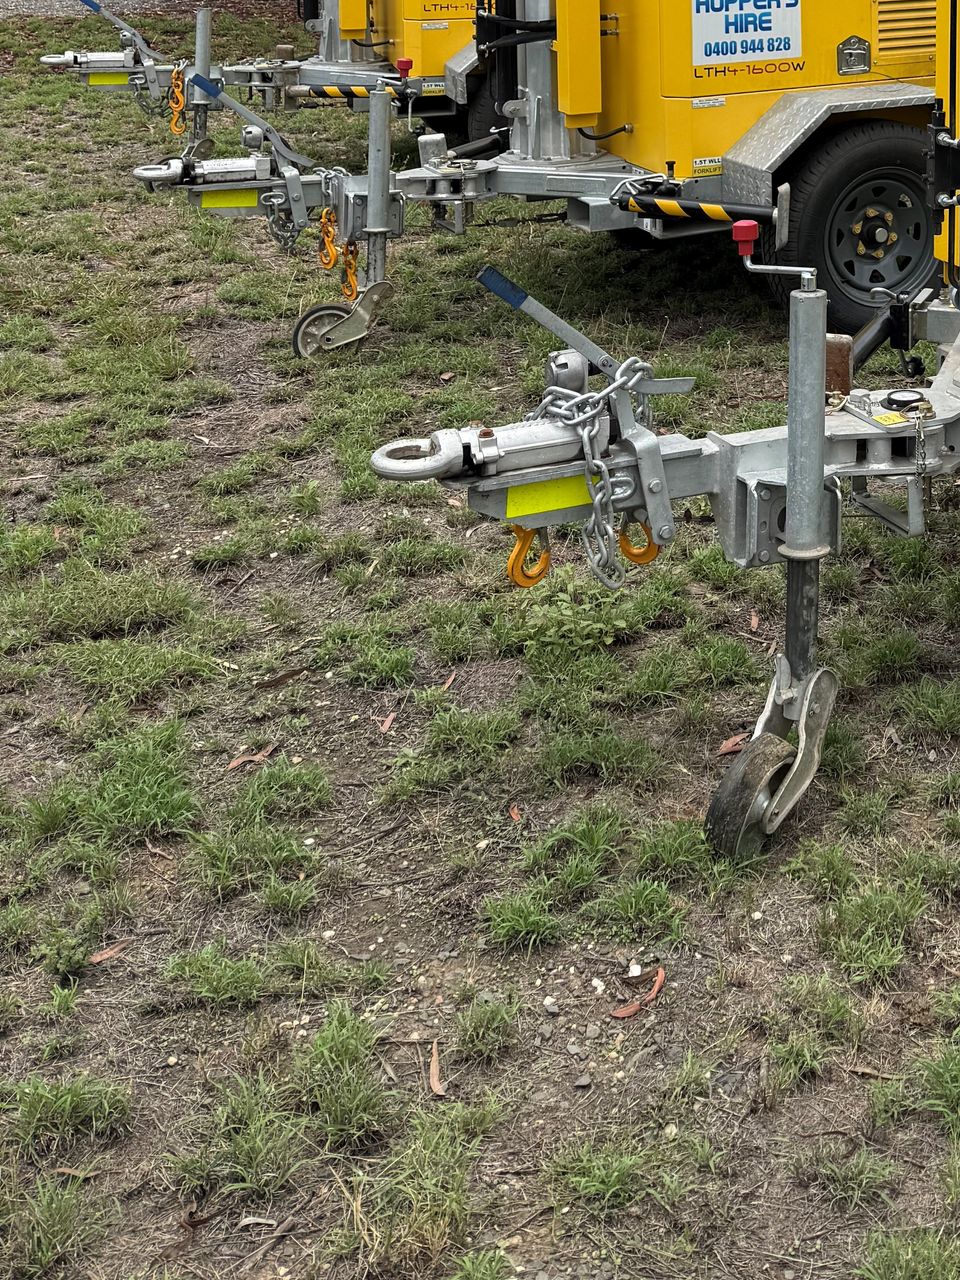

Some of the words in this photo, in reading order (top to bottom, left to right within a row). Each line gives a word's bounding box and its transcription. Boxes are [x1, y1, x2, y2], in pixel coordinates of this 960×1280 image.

[724, 12, 773, 35] HIRE
[704, 40, 737, 58] 0400
[740, 38, 765, 54] 944
[767, 36, 791, 52] 828
[694, 60, 806, 79] LTH4-1600W
[694, 167, 721, 175] FORKLIFT
